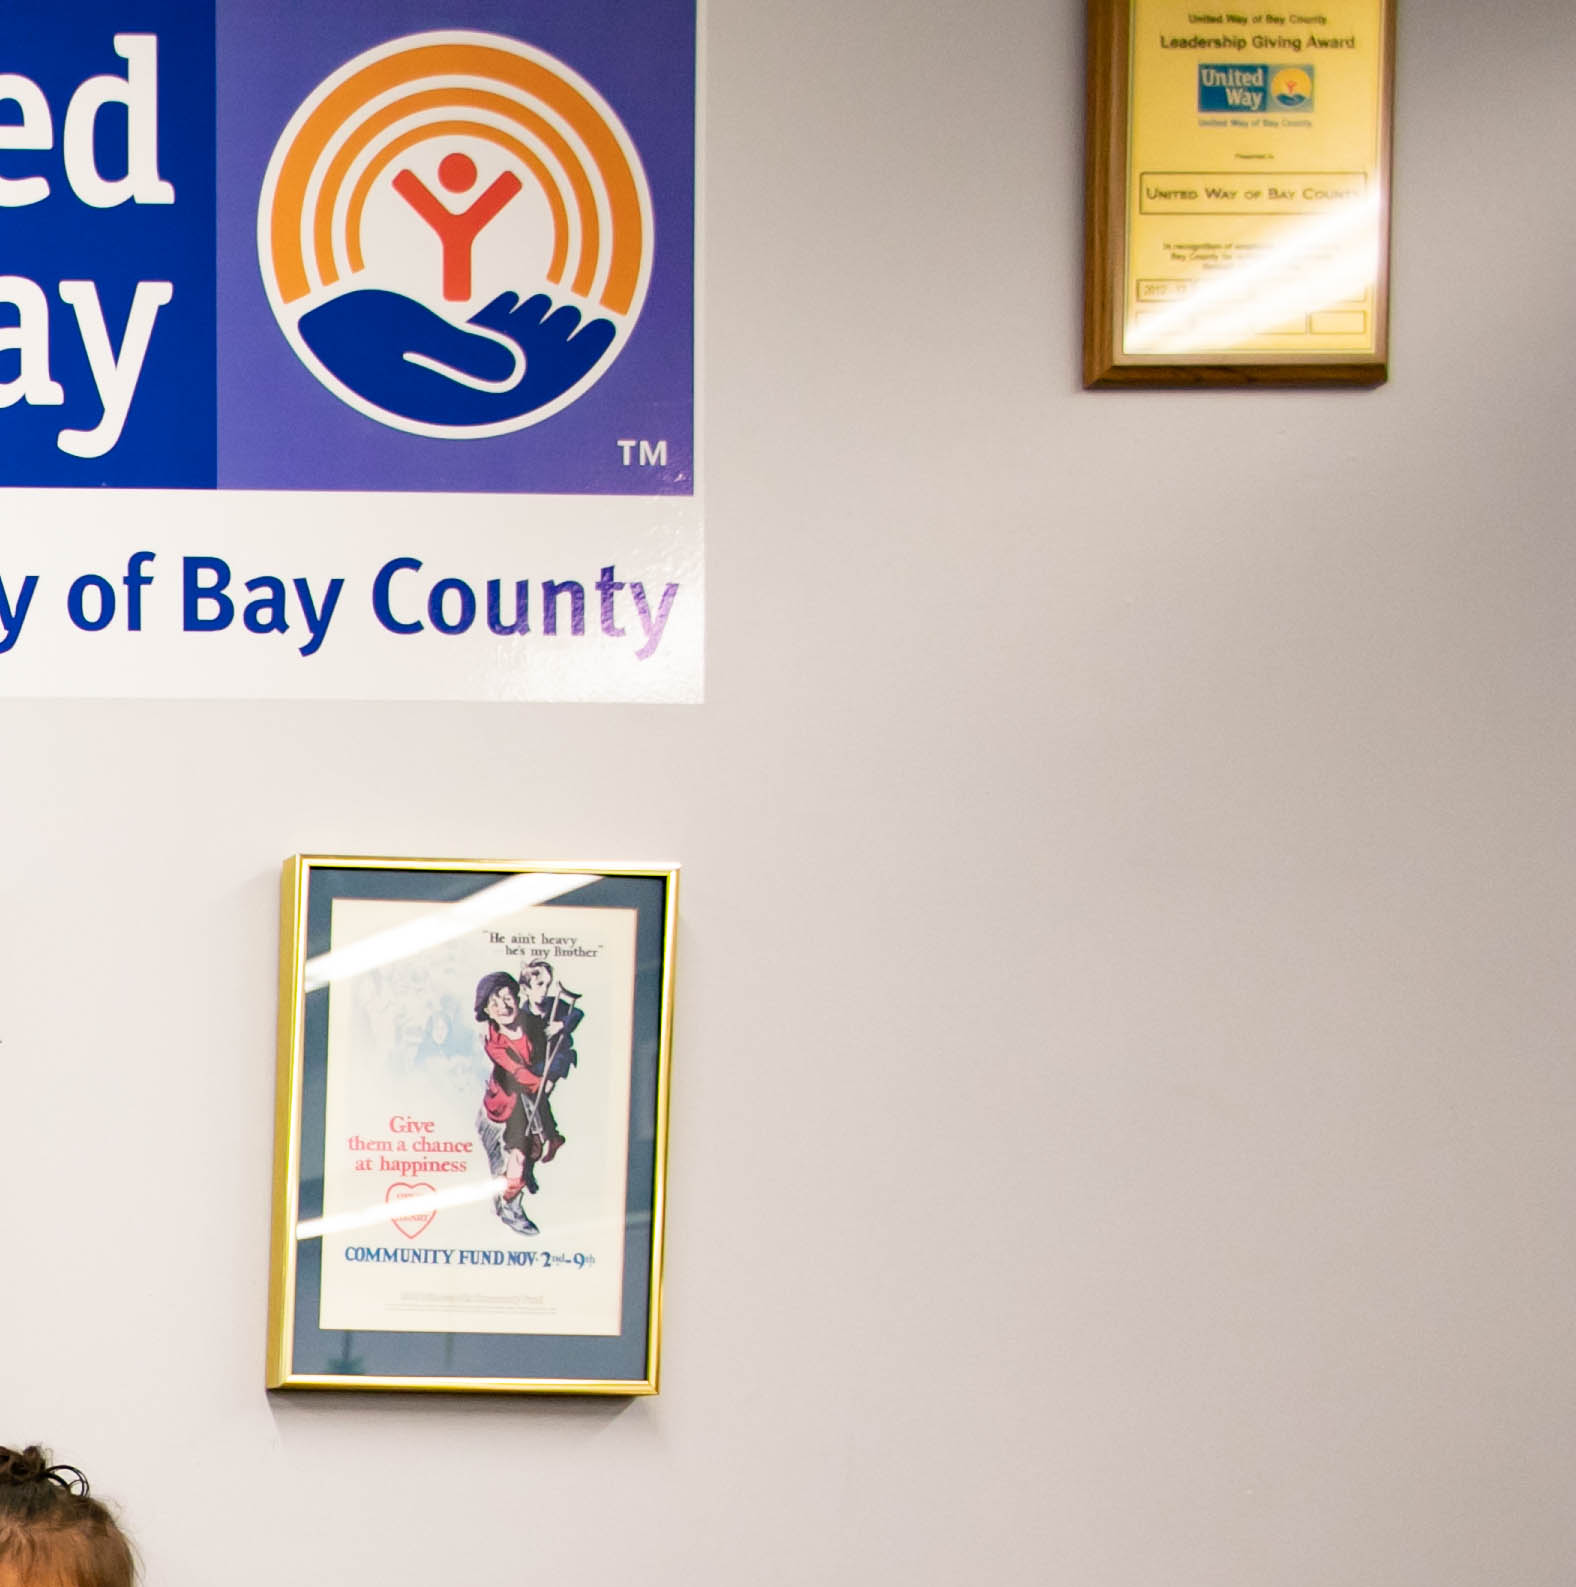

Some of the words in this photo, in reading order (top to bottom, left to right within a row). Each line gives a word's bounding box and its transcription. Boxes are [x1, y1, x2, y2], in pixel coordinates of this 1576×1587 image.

[1188, 15, 1222, 24] United
[1226, 15, 1247, 25] Way
[1253, 15, 1262, 24] of
[1266, 15, 1285, 25] Bay
[1289, 15, 1327, 25] County
[1160, 36, 1247, 51] Leadership
[1252, 36, 1301, 52] Giving
[1307, 36, 1355, 48] Award
[1201, 69, 1263, 86] United
[1225, 88, 1264, 110] Way
[617, 439, 668, 467] TM
[69, 551, 155, 633] of
[182, 556, 344, 657] Bay
[371, 556, 680, 661] County
[542, 933, 577, 948] heavy
[531, 948, 550, 959] my
[389, 1115, 435, 1134] Give
[348, 1136, 392, 1151] them
[397, 1140, 408, 1152] a
[412, 1137, 473, 1153] chance
[355, 1158, 373, 1171] at
[380, 1156, 467, 1177] happiness
[345, 1246, 455, 1264] COMMUNITY
[459, 1250, 505, 1266] FUND
